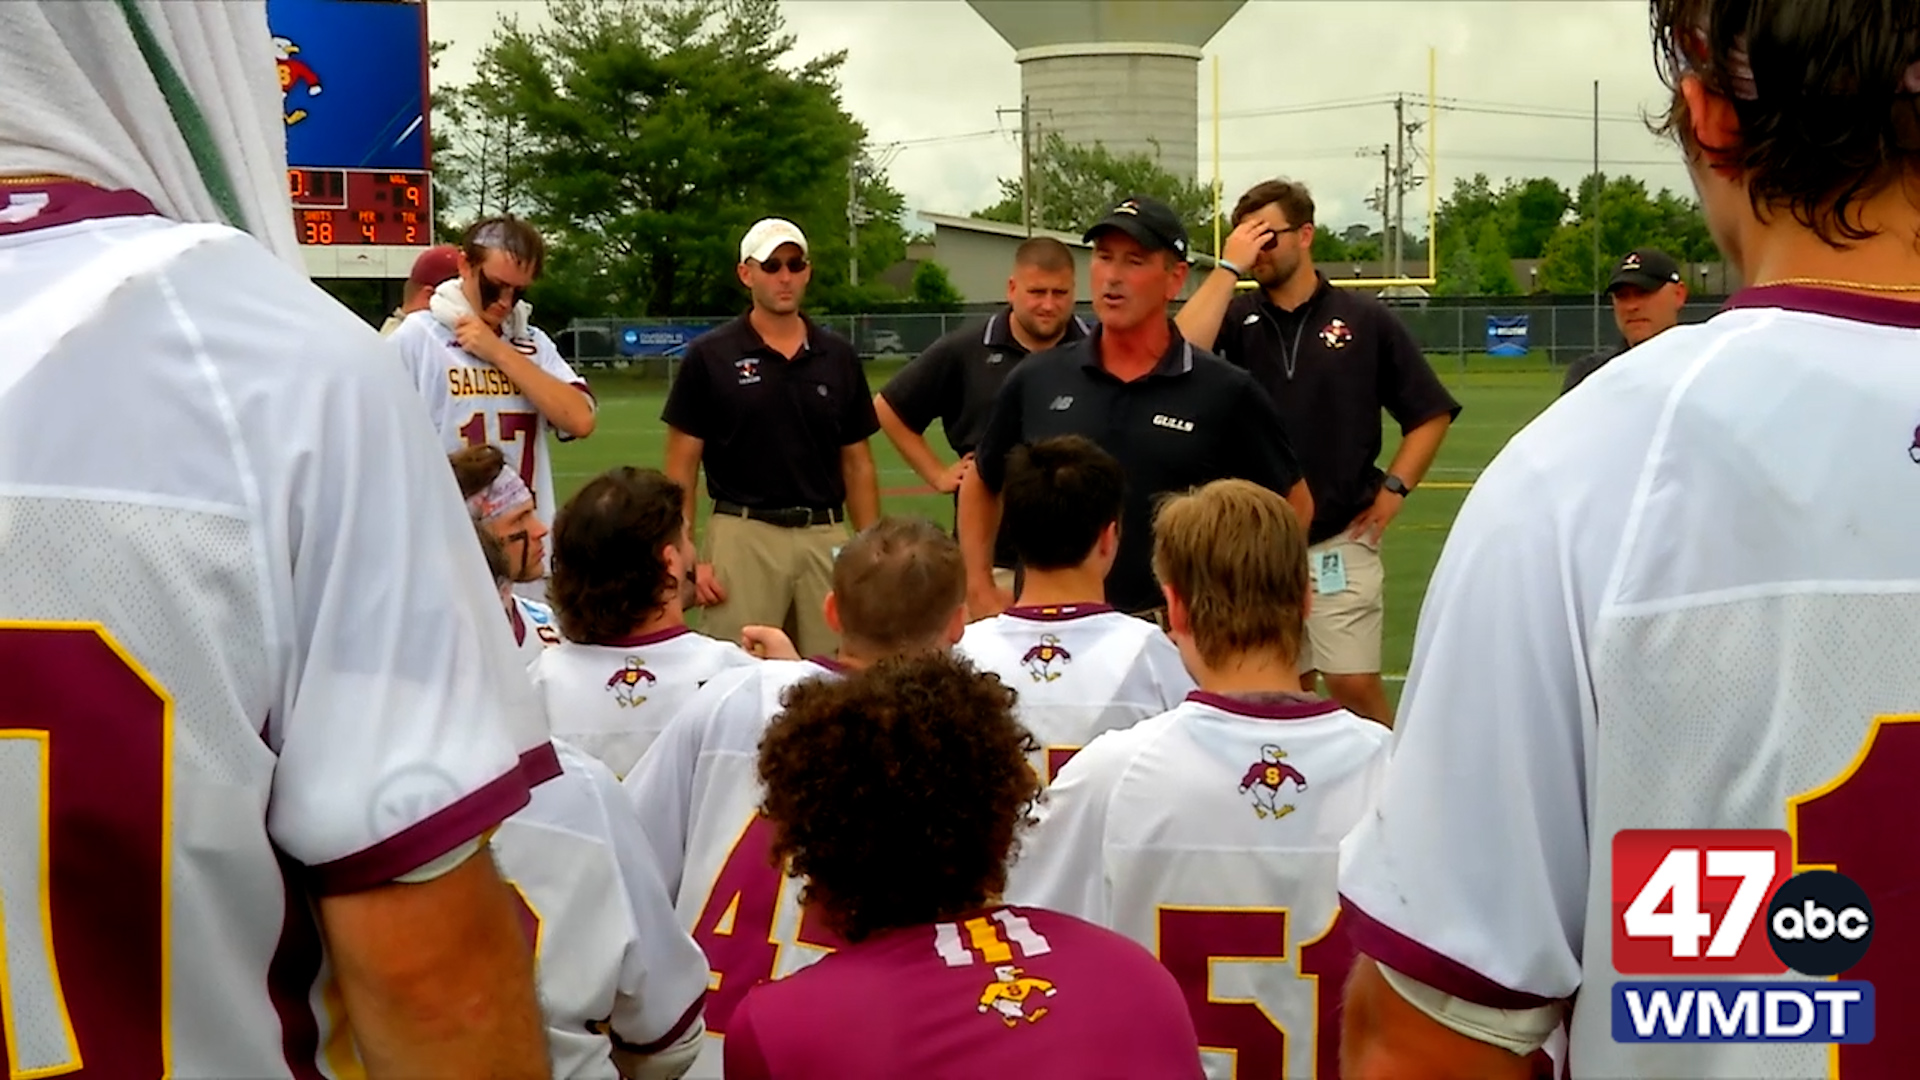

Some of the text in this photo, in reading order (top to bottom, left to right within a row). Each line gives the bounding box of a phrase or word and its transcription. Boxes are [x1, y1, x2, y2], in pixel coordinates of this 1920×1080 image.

[406, 186, 419, 207] 9
[358, 210, 376, 223] PER
[306, 222, 333, 244] 38
[362, 225, 375, 242] 4
[405, 226, 416, 243] 2
[1152, 414, 1195, 433] GULLS
